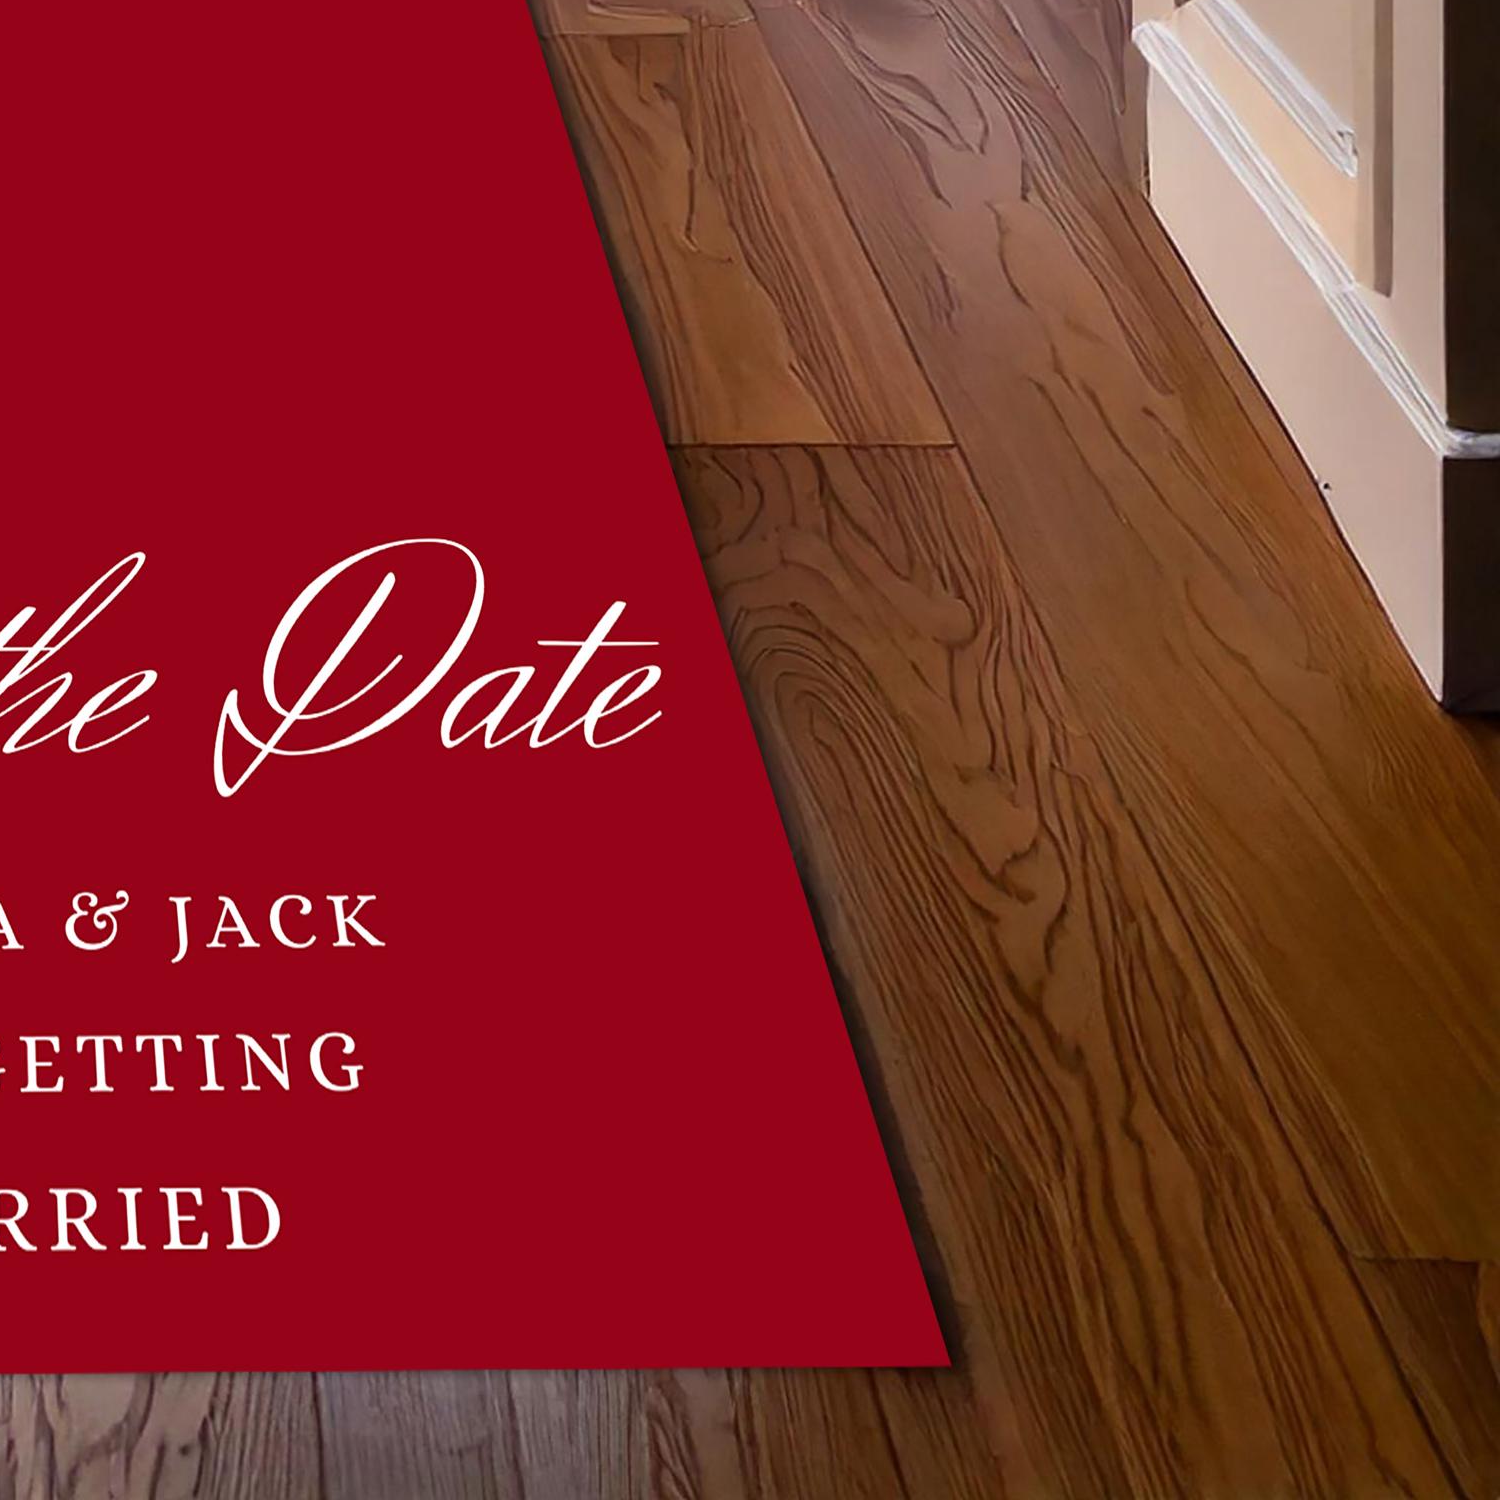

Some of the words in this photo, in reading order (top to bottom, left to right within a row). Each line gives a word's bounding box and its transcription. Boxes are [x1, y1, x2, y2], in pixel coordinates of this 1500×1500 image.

[214, 538, 662, 797] Date
[65, 890, 129, 950] &
[169, 895, 385, 963] JACK
